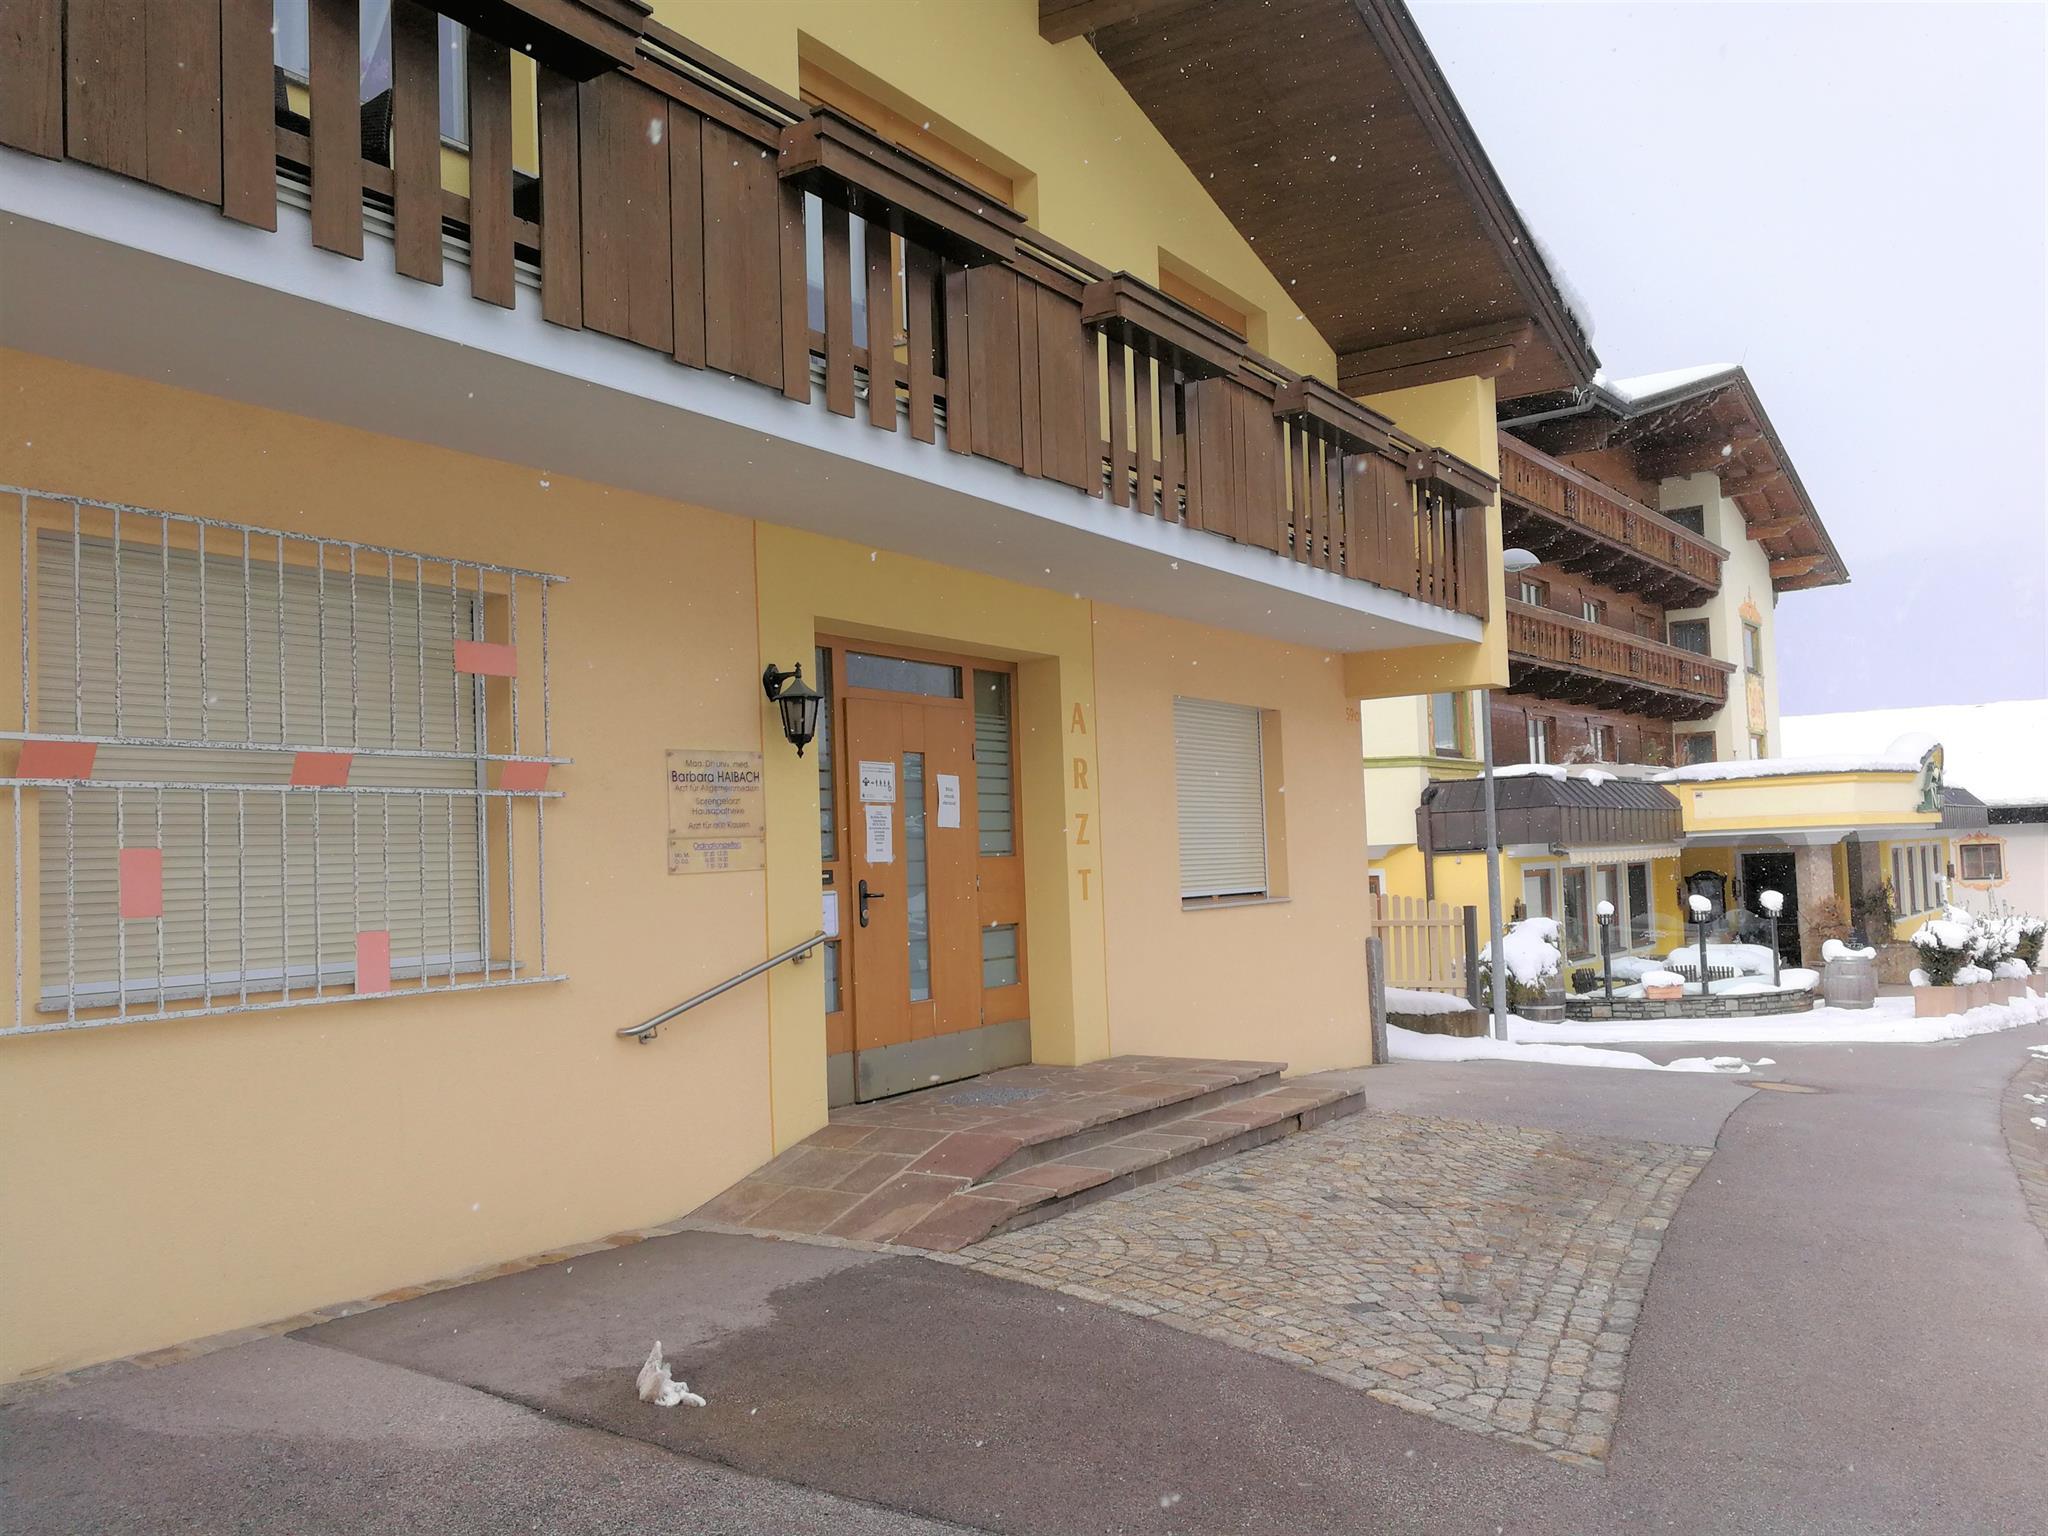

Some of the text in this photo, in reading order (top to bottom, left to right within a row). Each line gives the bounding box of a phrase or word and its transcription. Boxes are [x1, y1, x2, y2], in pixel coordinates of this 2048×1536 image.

[671, 770, 760, 783] Barbara HAIBACH
[1070, 702, 1092, 901] ARZT
